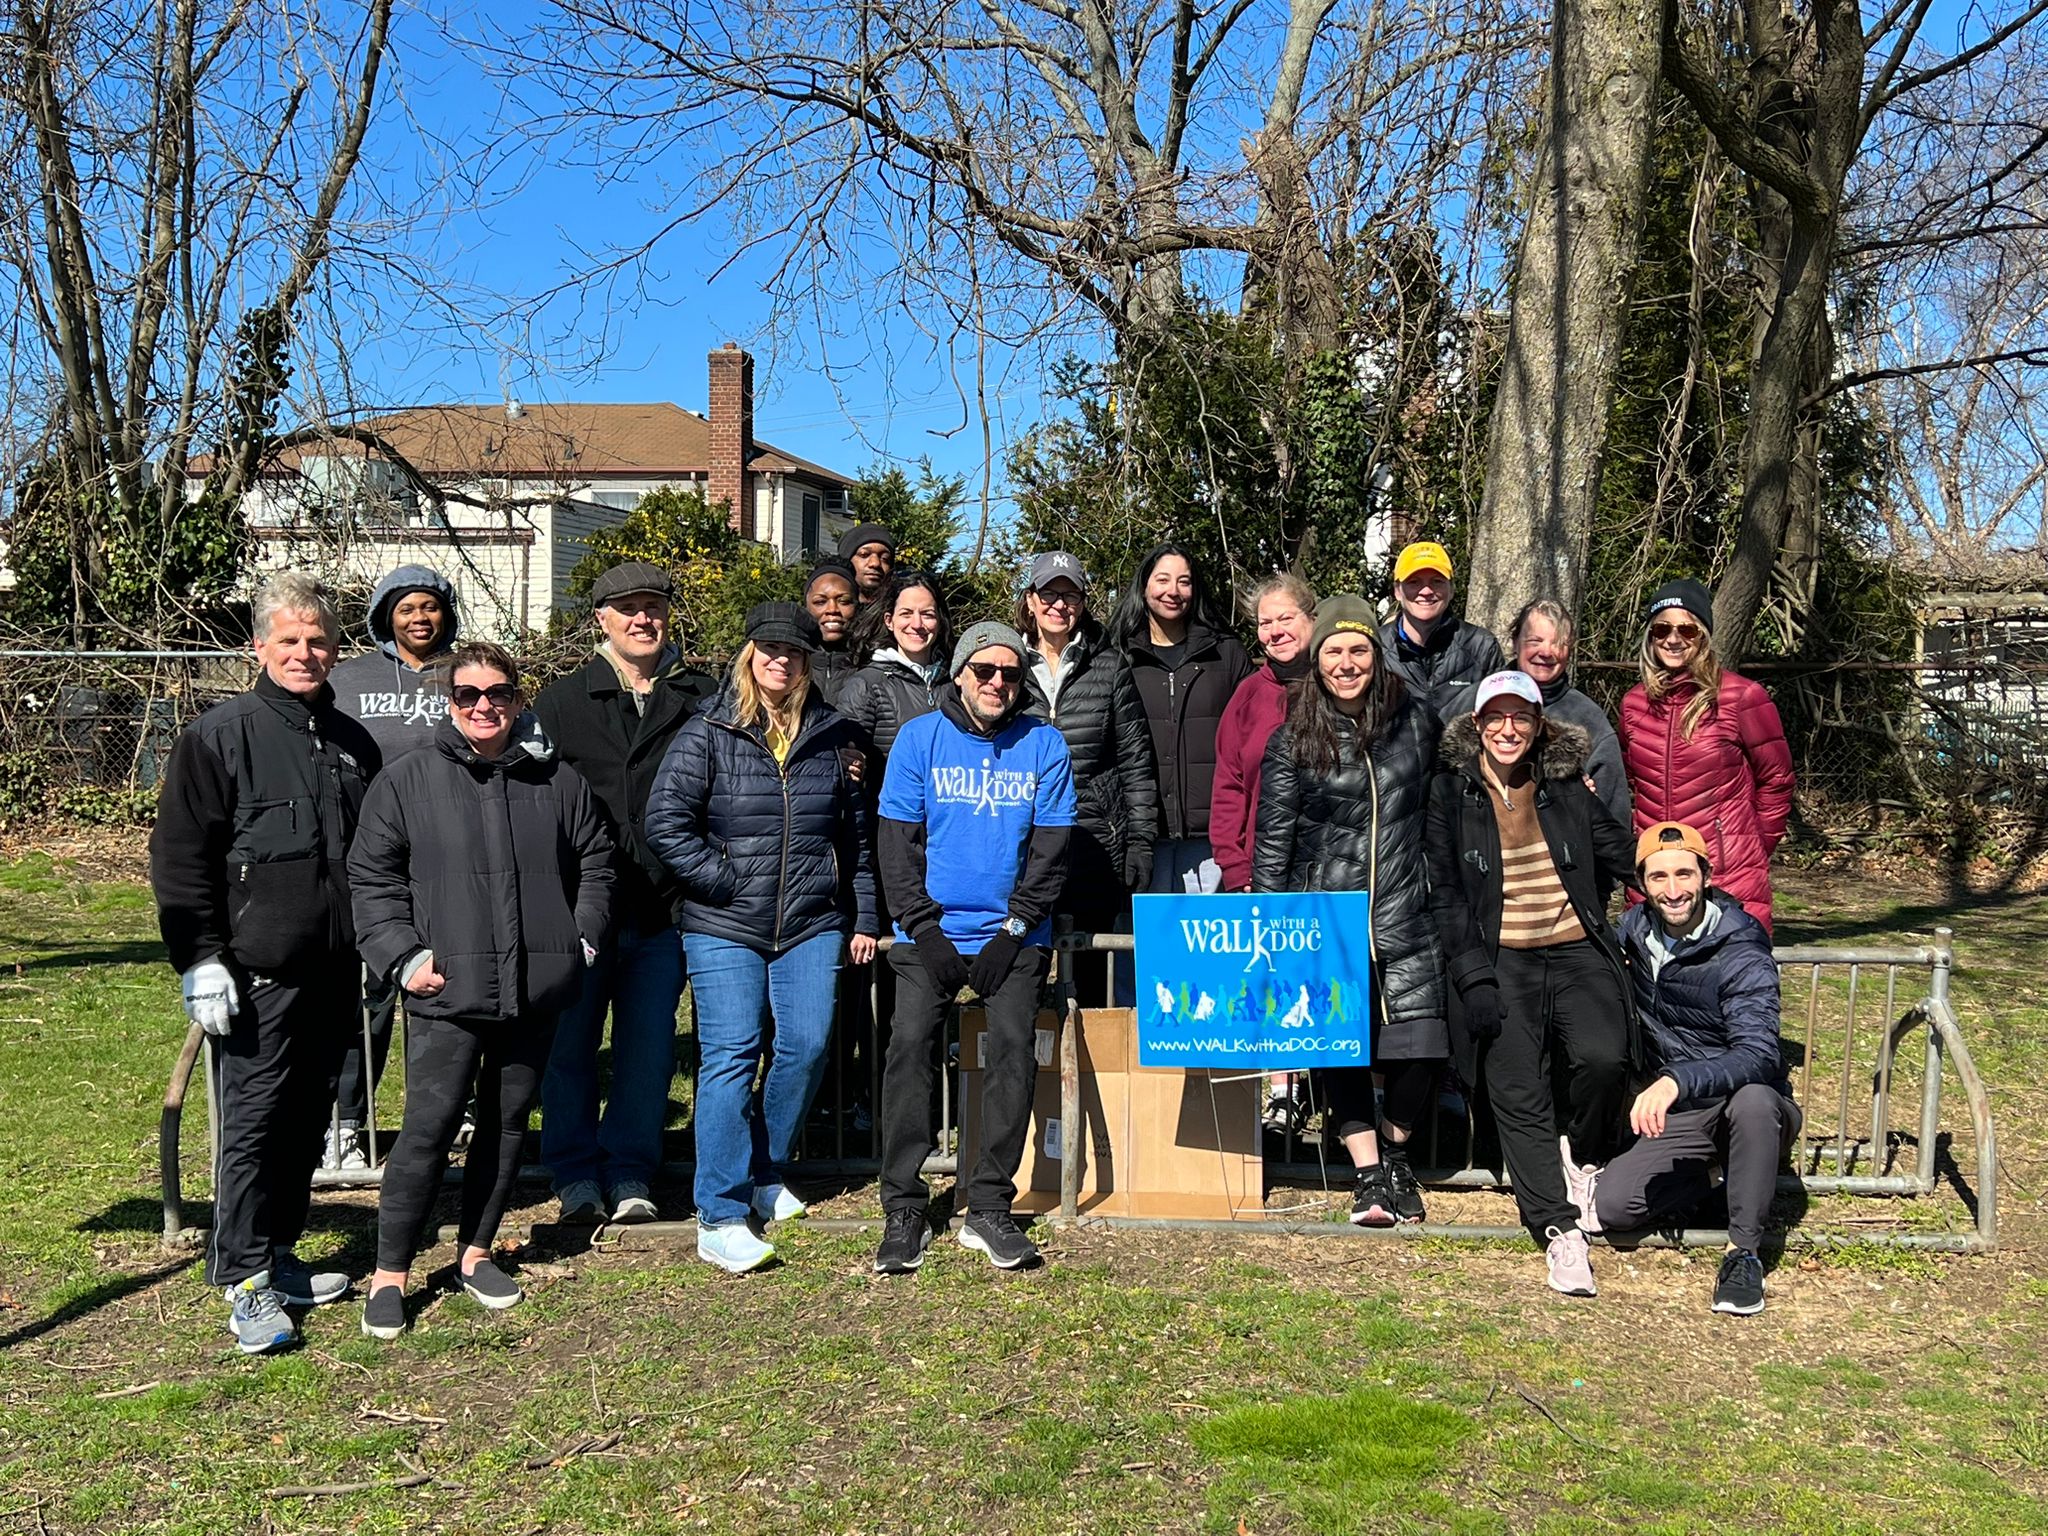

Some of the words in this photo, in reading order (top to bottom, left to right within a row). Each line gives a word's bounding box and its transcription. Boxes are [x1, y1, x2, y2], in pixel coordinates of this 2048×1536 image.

[1026, 771, 1035, 781] a
[994, 781, 1036, 800] DOC
[1310, 918, 1320, 929] a
[1271, 930, 1322, 952] DOC
